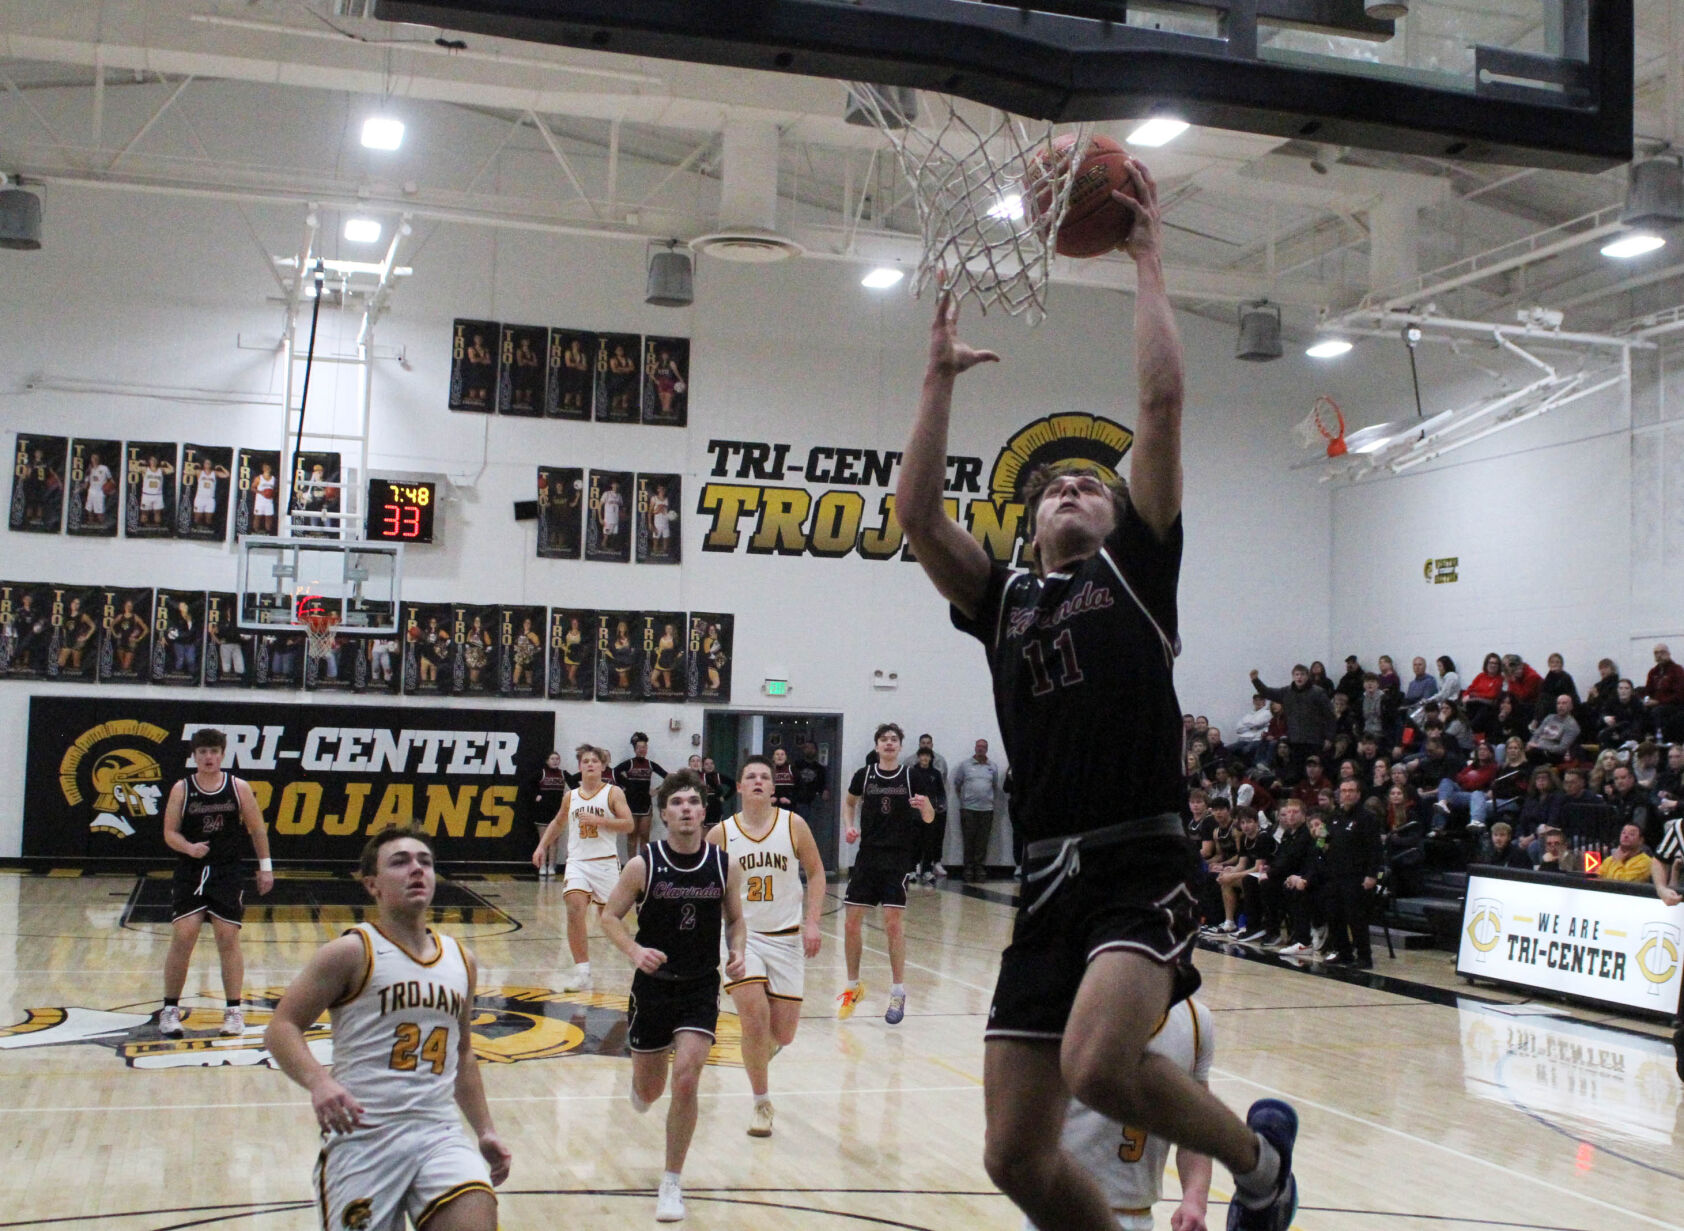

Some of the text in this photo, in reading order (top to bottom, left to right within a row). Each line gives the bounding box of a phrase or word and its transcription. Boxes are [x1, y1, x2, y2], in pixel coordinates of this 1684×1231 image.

[707, 440, 983, 493] TRI-CENR
[390, 485, 430, 506] 7:48
[382, 504, 421, 538] 33
[696, 482, 1037, 568] TROJN
[1022, 628, 1084, 696] 11
[202, 814, 224, 833] 24
[739, 852, 788, 872] ROJANS
[653, 881, 721, 899] Clarinda
[747, 875, 774, 901] 21
[680, 903, 696, 930] 2
[1537, 912, 1600, 941] WE ARE
[1507, 934, 1627, 981] TRI-CENTER
[377, 981, 465, 1019] TROJAN
[388, 1022, 449, 1076] 24
